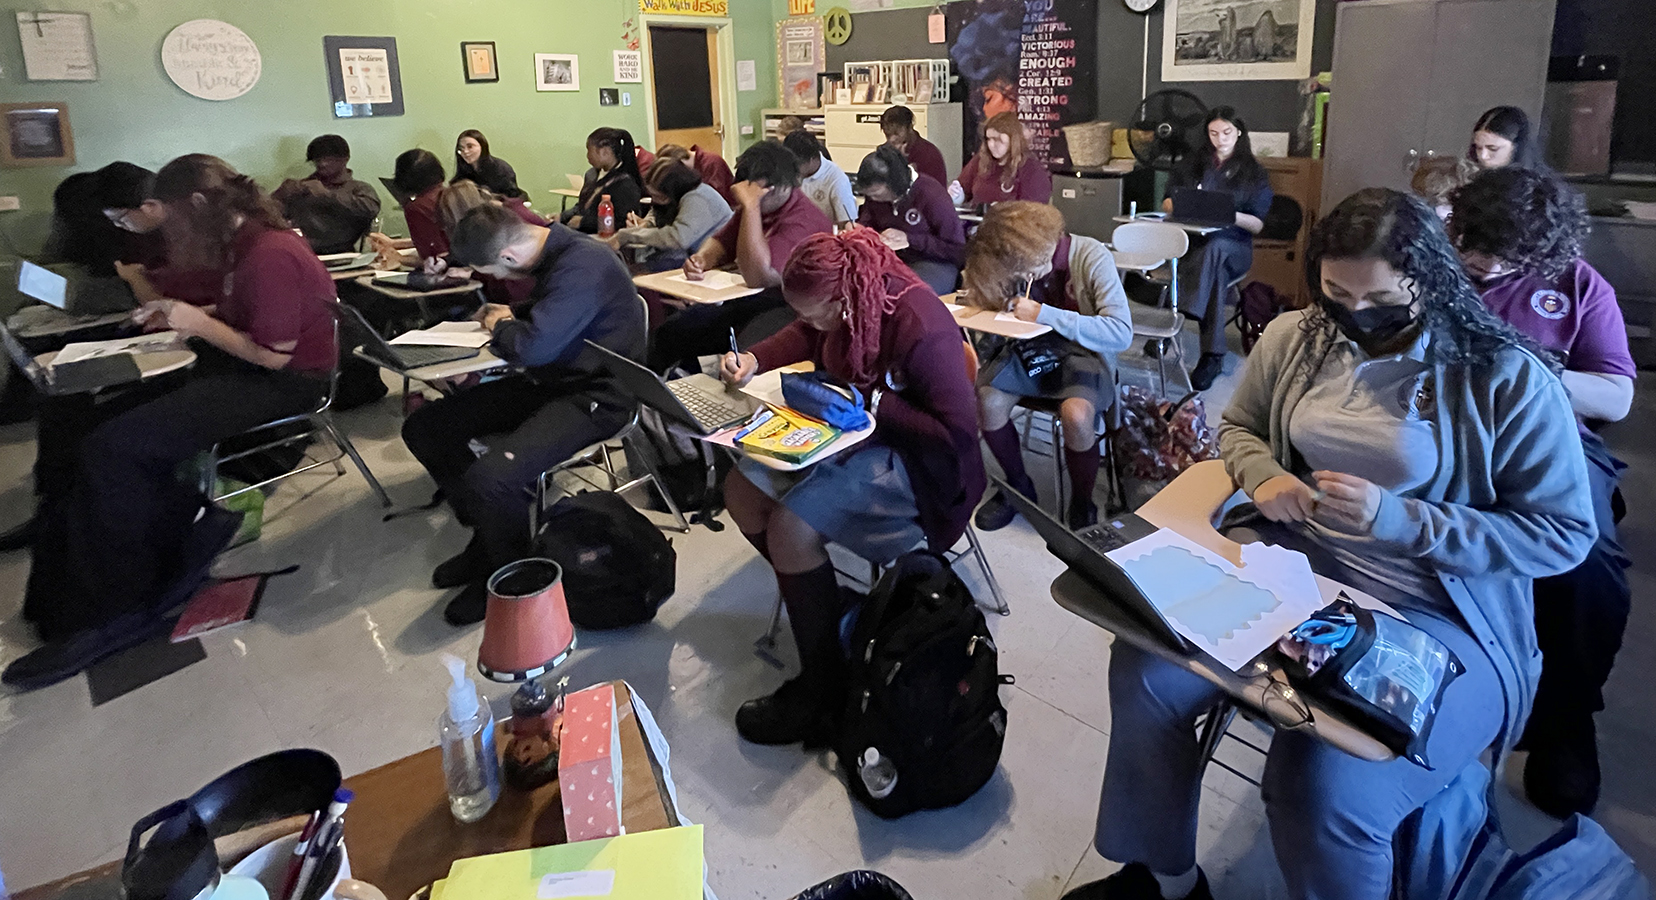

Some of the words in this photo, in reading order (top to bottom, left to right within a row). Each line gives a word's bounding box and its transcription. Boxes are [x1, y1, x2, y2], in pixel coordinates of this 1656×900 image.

[692, 0, 726, 13] JESUS
[1024, 0, 1053, 11] YOU
[1021, 40, 1076, 51] VICTORIOUS
[357, 54, 385, 62] believe
[1020, 50, 1040, 58] Rom.
[1019, 57, 1077, 69] ENOUGH
[1026, 70, 1043, 78] Cor.
[1018, 77, 1073, 88] CREATED
[1018, 95, 1069, 105] STRONG
[1017, 112, 1060, 121] AMAZING
